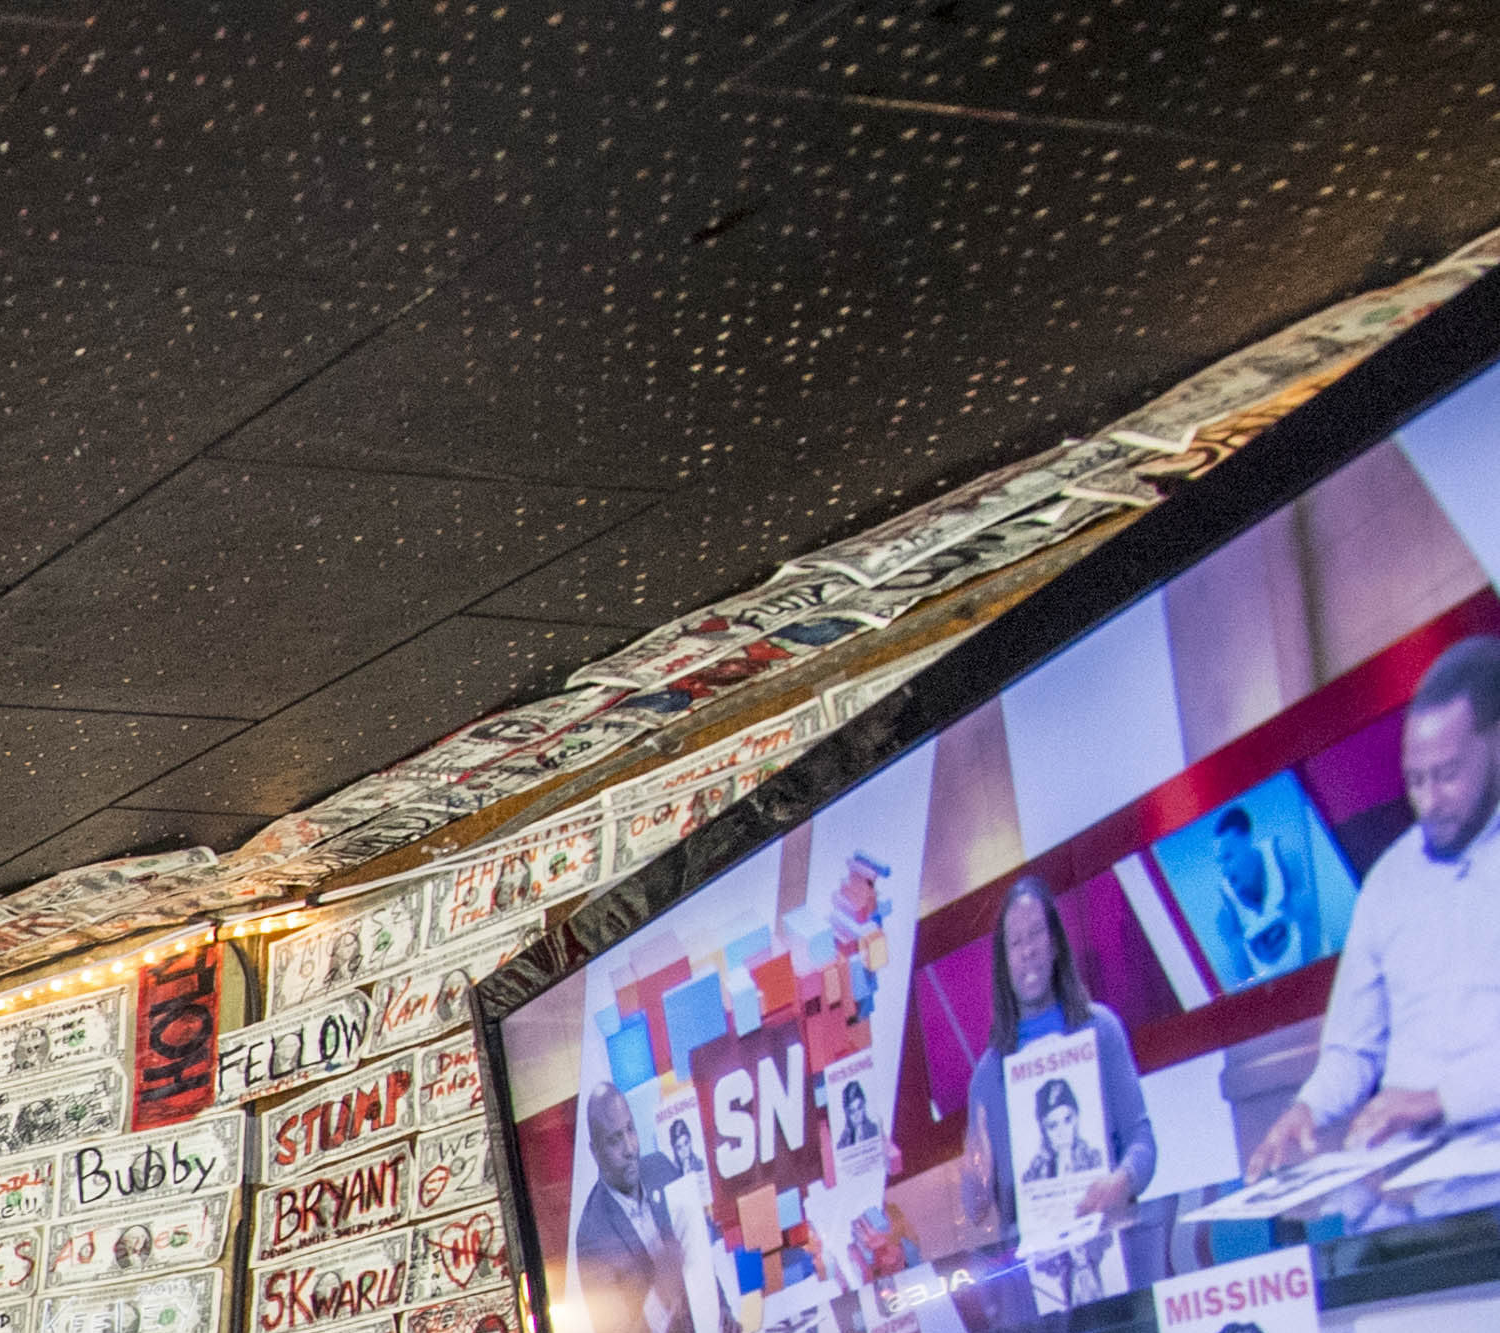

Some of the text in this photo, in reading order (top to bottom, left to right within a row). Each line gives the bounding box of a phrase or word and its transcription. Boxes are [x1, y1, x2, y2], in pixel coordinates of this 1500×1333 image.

[141, 952, 218, 1104] HOLT
[218, 1005, 372, 1093] FELLOW
[1011, 1045, 1095, 1083] MISSING
[275, 1070, 412, 1166] STUMP
[75, 1142, 216, 1206] Bubby
[274, 1157, 404, 1246] BRYANT
[1166, 1266, 1310, 1326] MISSING
